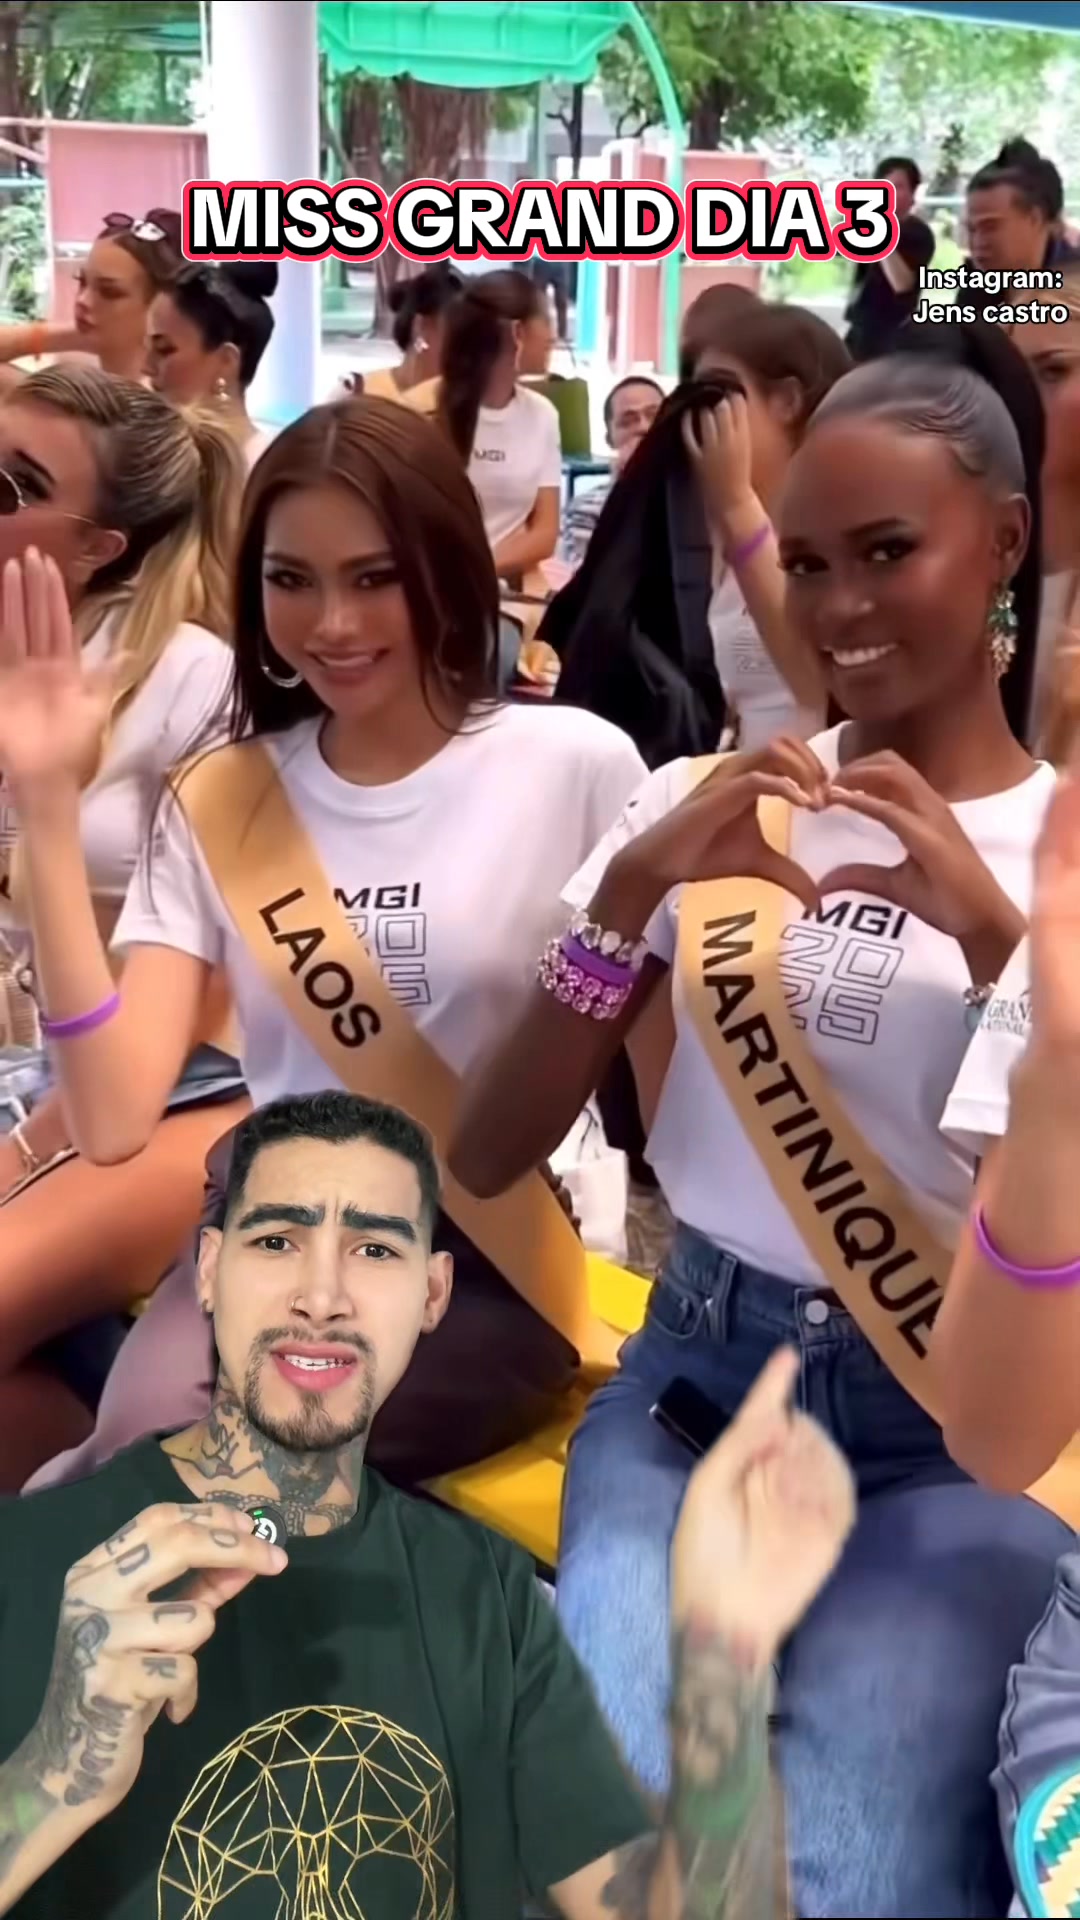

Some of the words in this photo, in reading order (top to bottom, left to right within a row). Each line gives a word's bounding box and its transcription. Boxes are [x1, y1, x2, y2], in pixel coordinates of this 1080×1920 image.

[333, 881, 421, 910] MGI
[801, 901, 908, 940] MGI
[258, 887, 382, 1048] LAOS
[778, 923, 905, 989] 20
[702, 909, 944, 1360] MARTINIQUE
